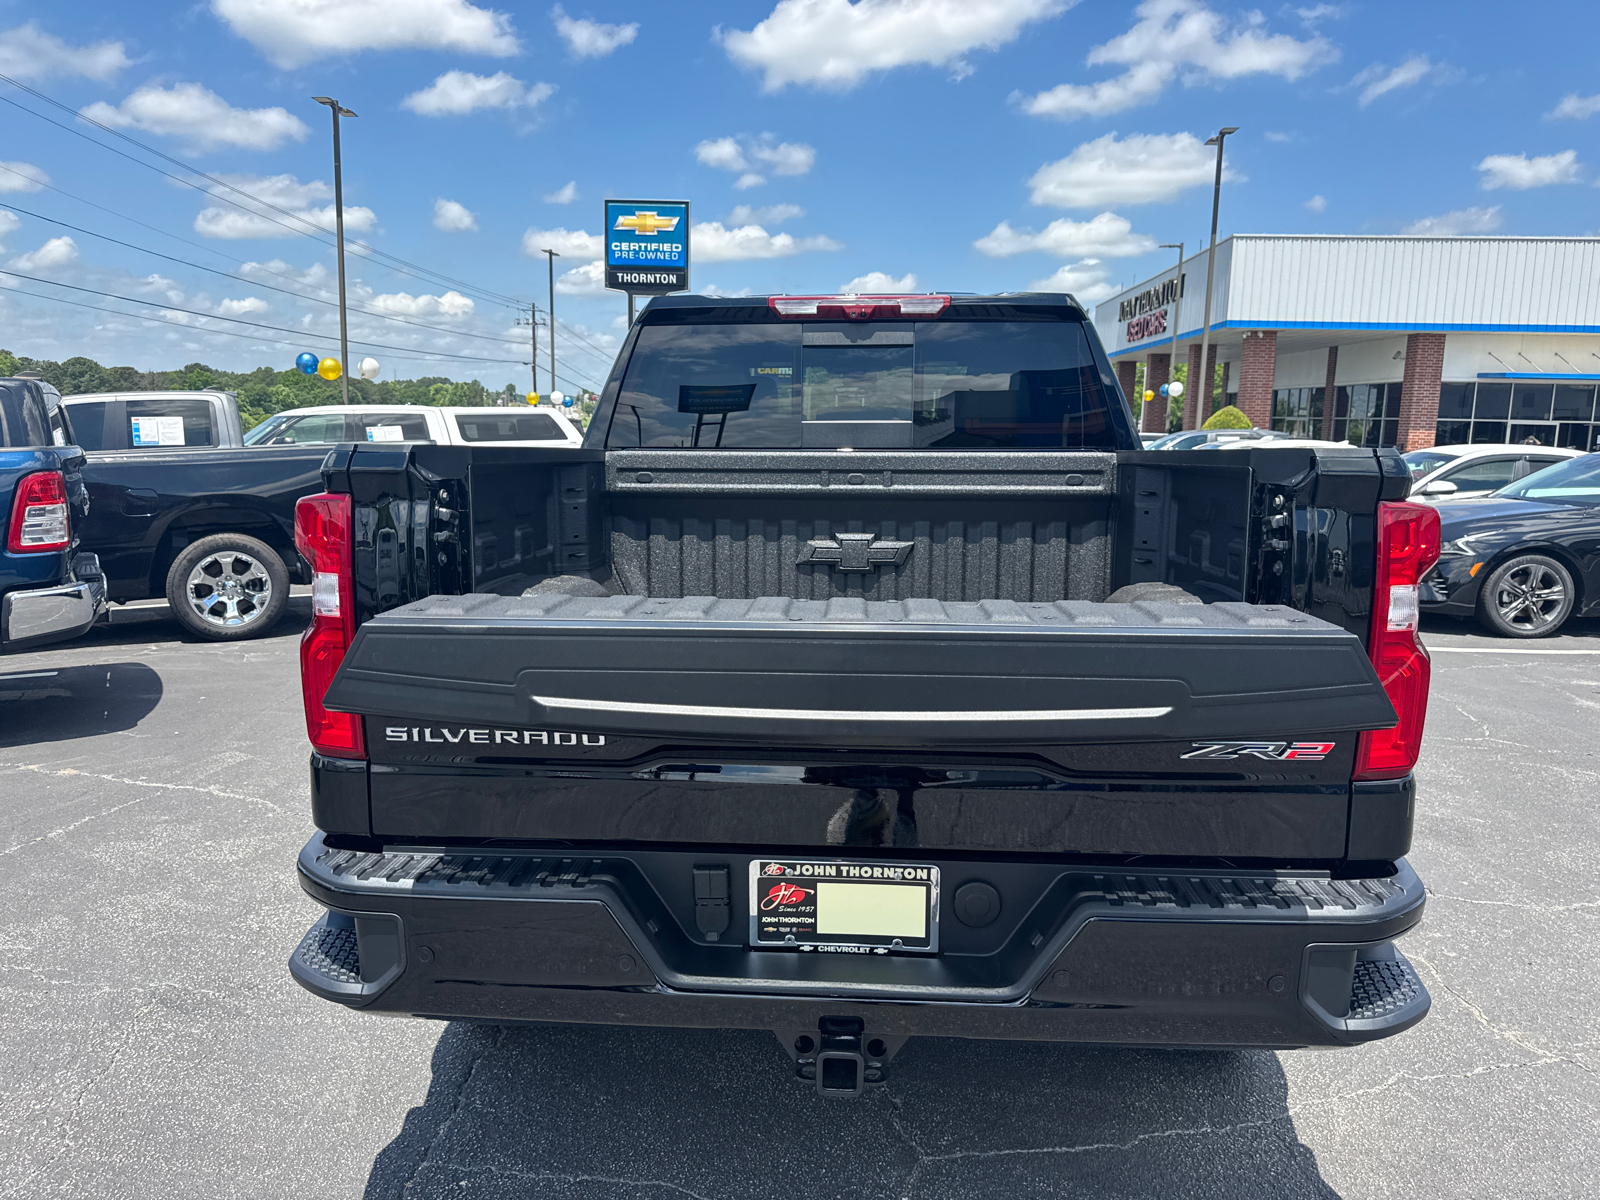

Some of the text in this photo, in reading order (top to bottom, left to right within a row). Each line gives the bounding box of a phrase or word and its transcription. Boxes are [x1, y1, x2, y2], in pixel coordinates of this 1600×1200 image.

[611, 242, 682, 252] CERTIFIED
[614, 251, 679, 260] PRE-OWNED
[616, 273, 677, 284] THORNTON
[1126, 309, 1168, 342] USED CARS
[385, 726, 606, 746] SILVERADO
[1180, 741, 1336, 761] ZR2
[794, 864, 837, 876] JOHN
[840, 866, 928, 880] THORNTON
[779, 916, 815, 924] THORNTON
[817, 945, 871, 954] CHEVROLET
